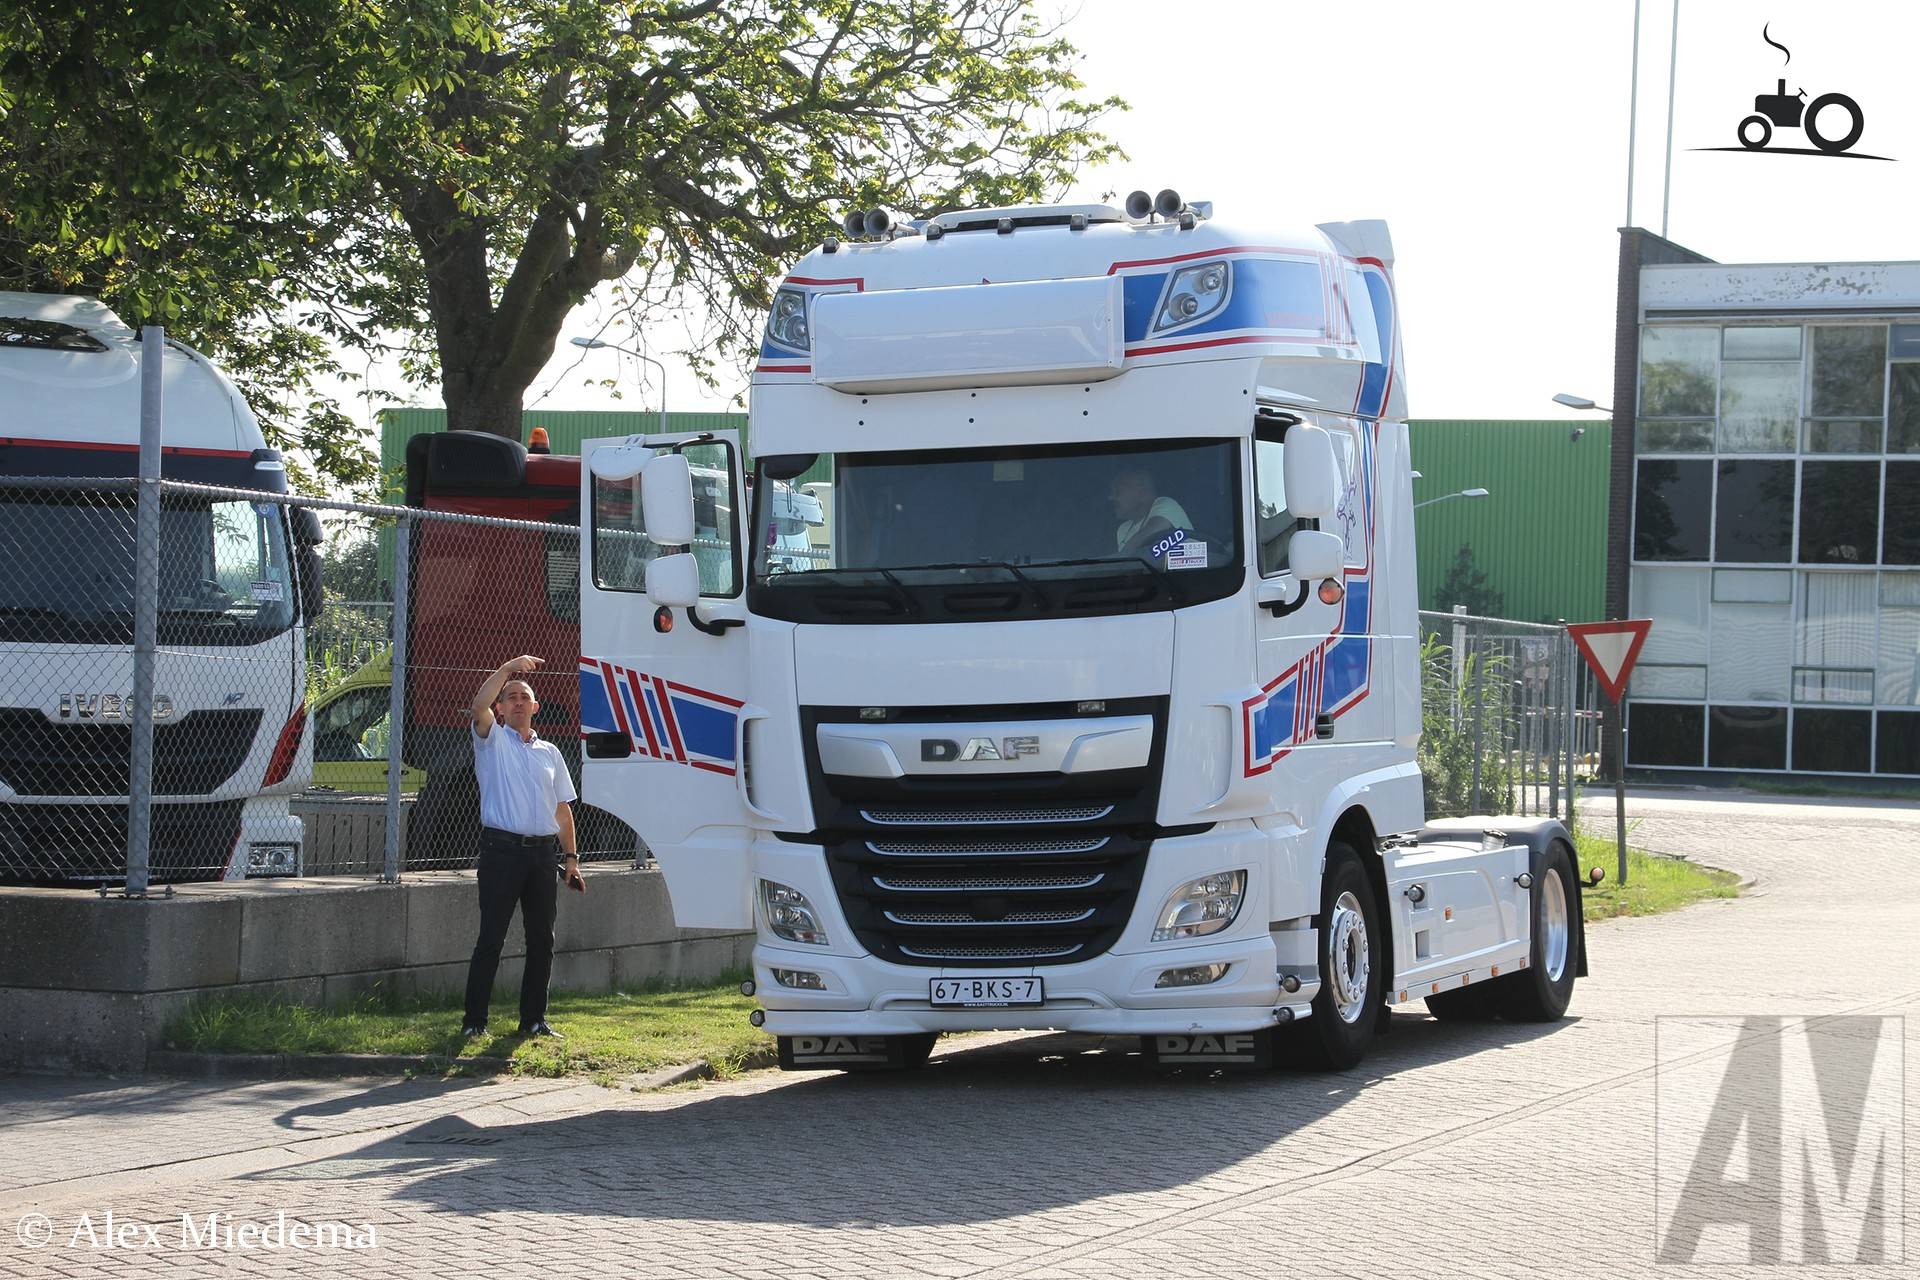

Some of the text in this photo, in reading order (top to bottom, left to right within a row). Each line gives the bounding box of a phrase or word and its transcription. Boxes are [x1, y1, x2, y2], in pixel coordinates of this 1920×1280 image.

[1152, 529, 1184, 557] SOLD
[921, 736, 1040, 762] DAF
[935, 980, 1035, 1000] 67-BKS-7
[792, 1036, 886, 1054] DAF
[1156, 1034, 1255, 1053] DAF
